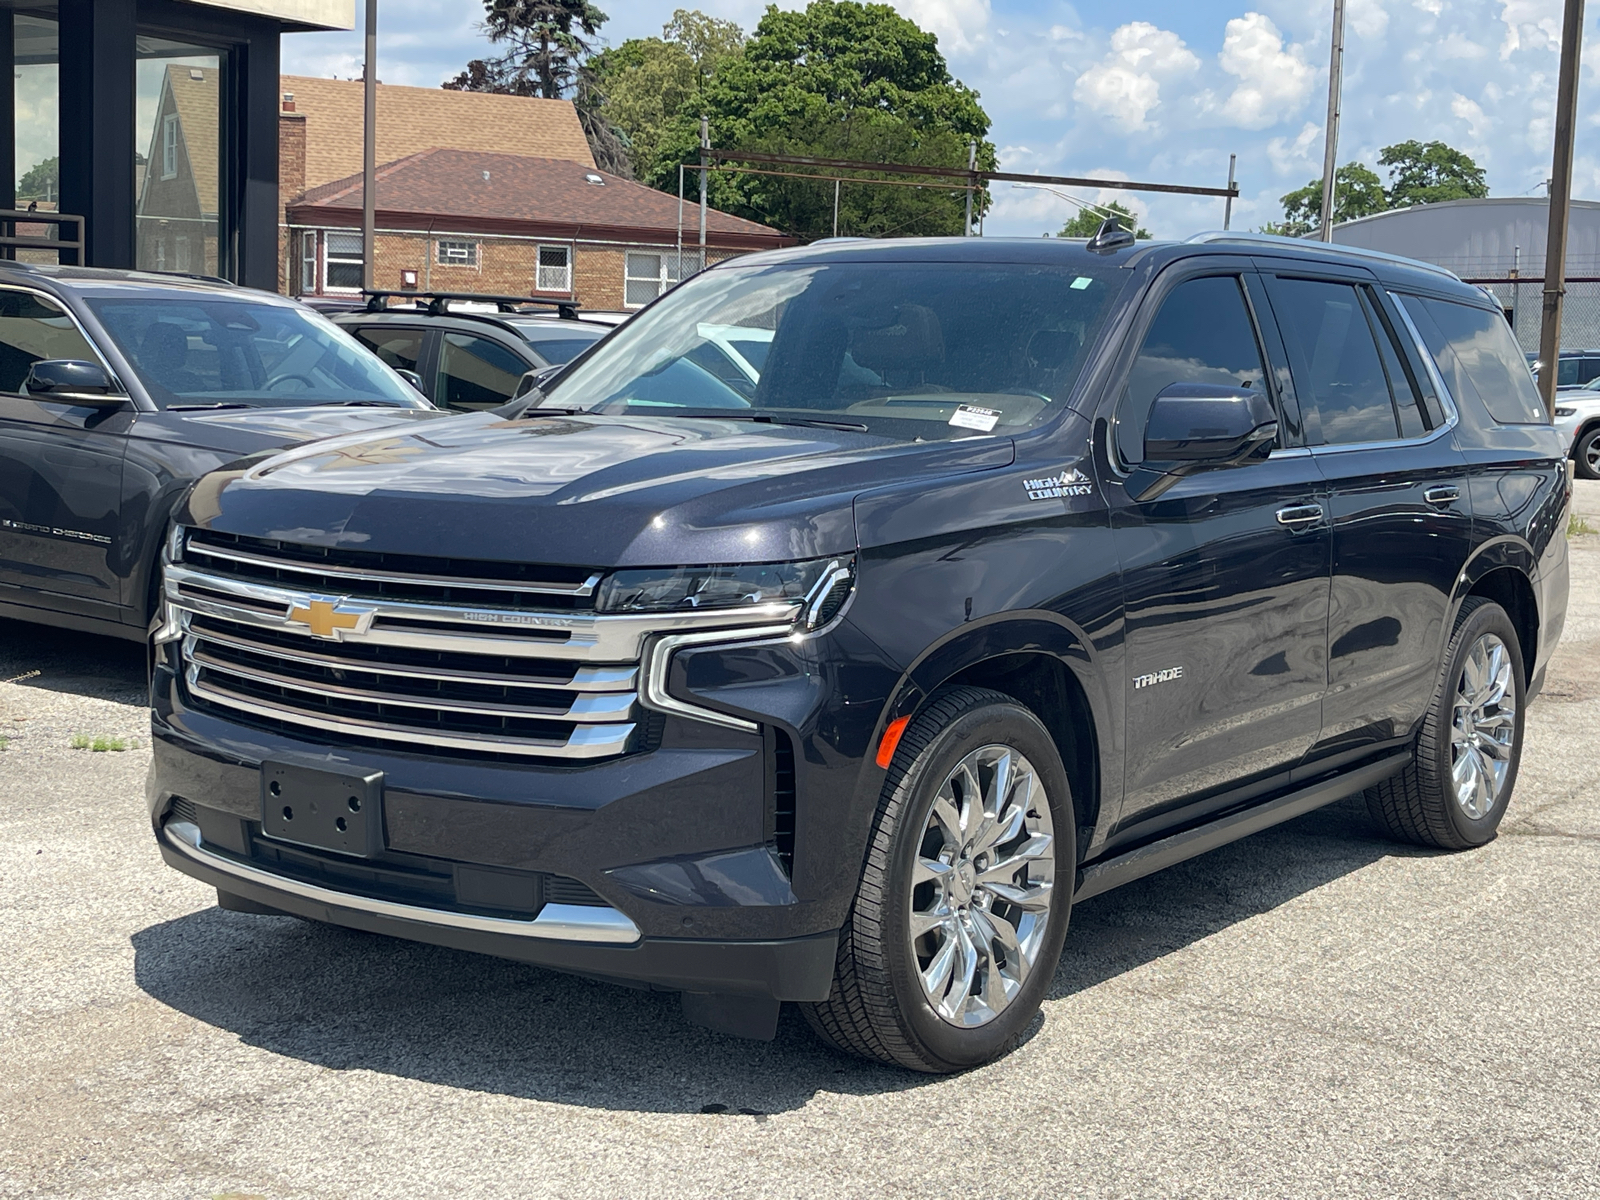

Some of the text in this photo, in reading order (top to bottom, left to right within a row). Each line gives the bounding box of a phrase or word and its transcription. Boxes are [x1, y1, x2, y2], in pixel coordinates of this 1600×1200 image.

[1023, 477, 1059, 490] HIGH
[1028, 485, 1093, 500] COUNTRY
[463, 612, 573, 627] HIGH COUNTRY
[1132, 666, 1183, 689] TAHOE
